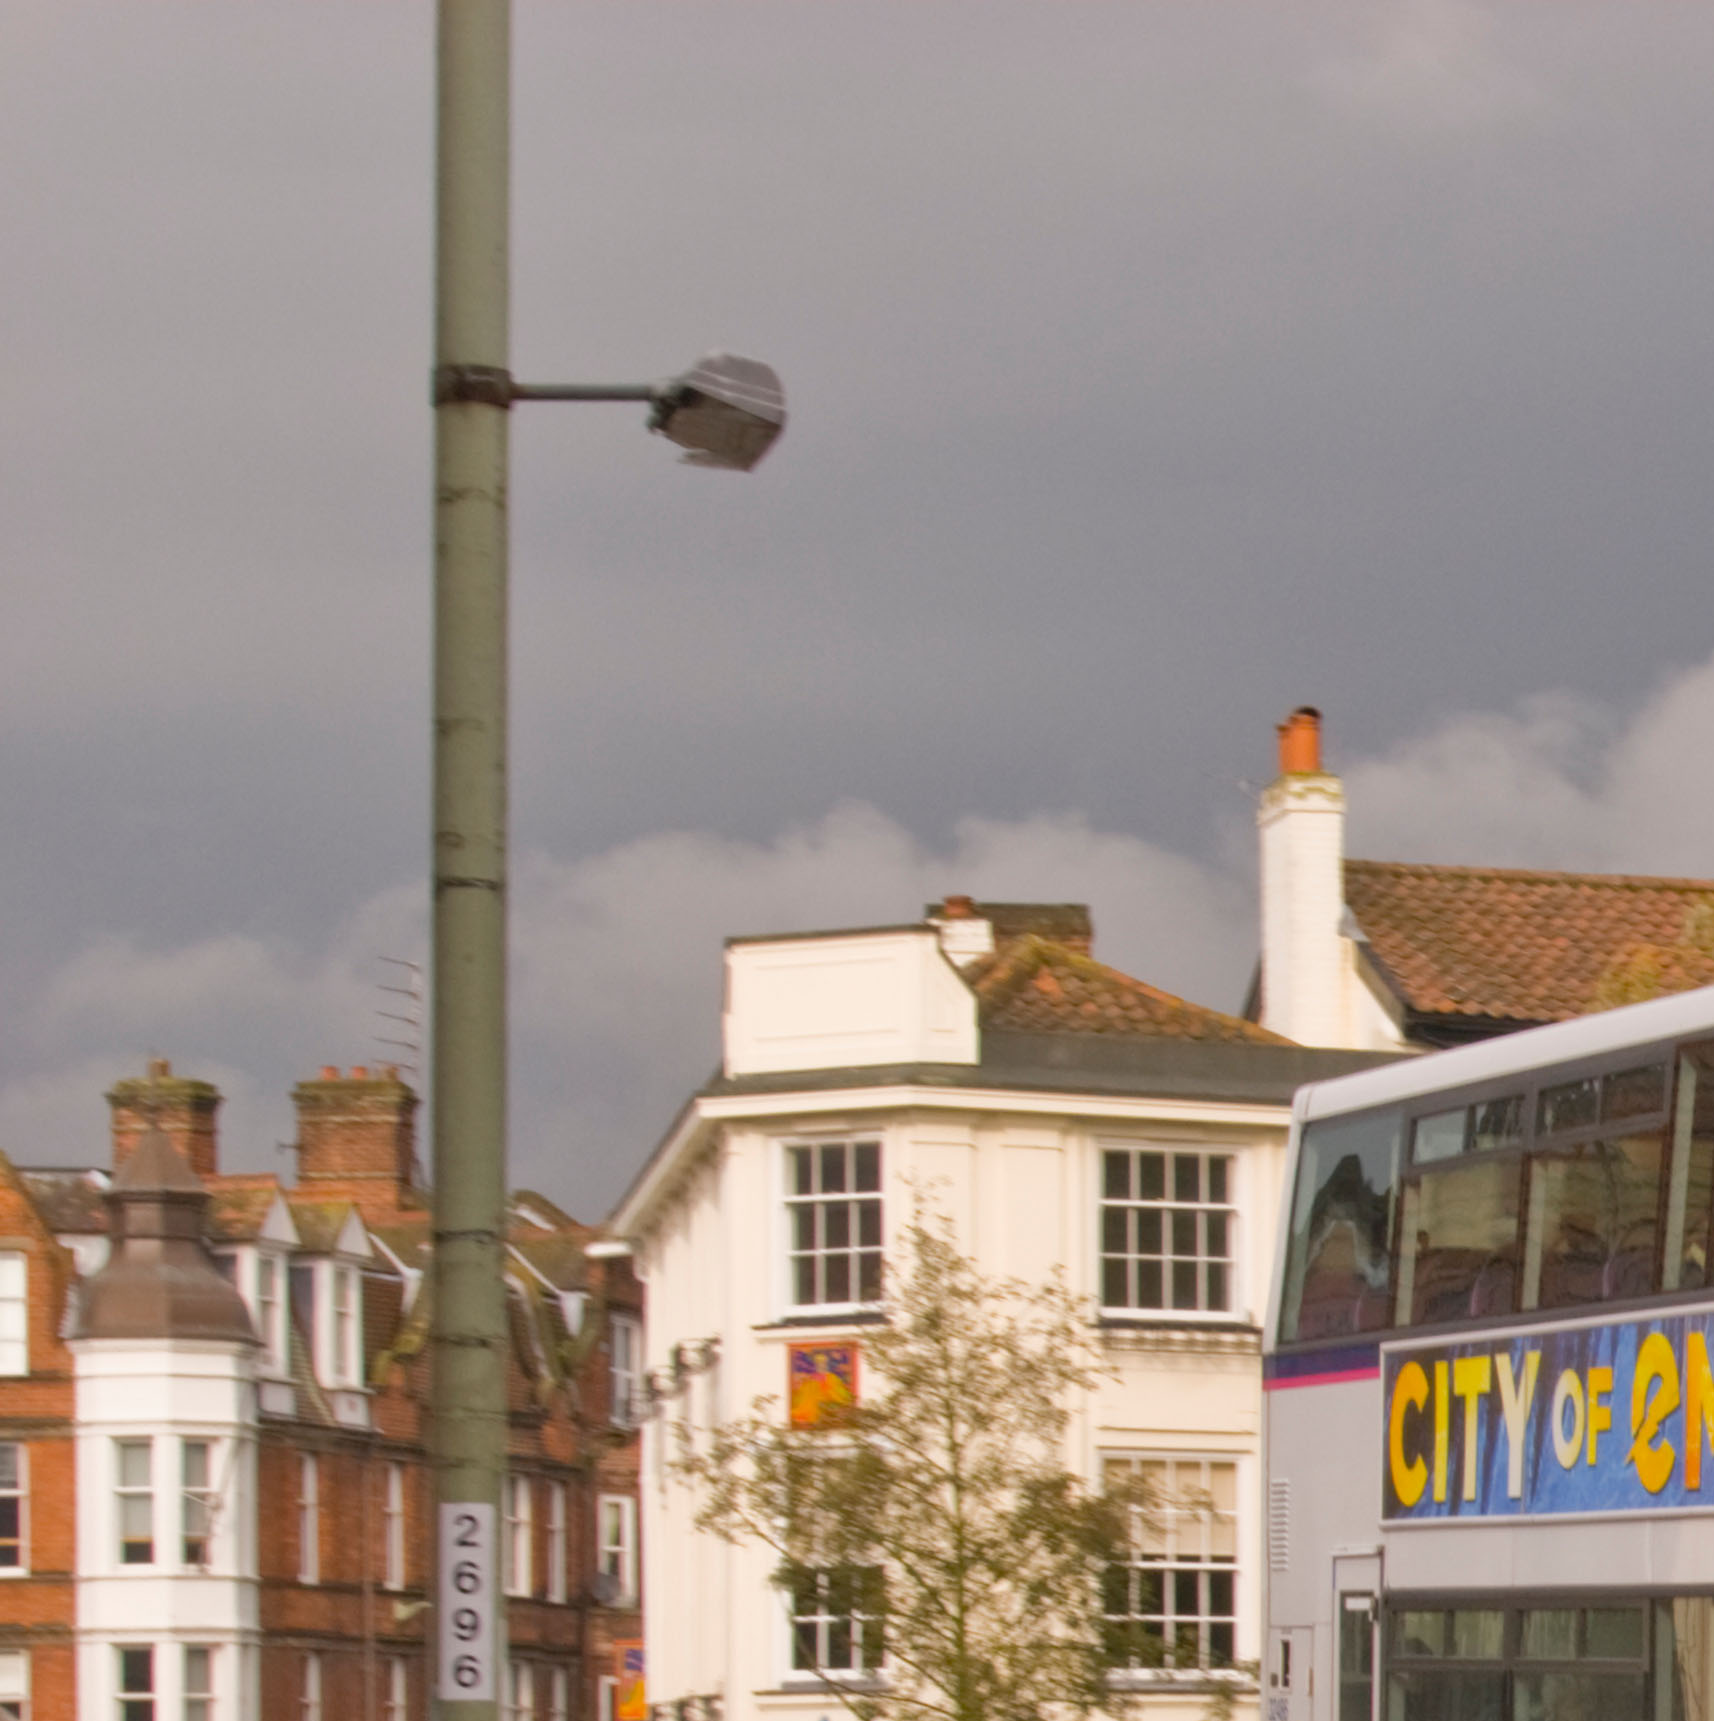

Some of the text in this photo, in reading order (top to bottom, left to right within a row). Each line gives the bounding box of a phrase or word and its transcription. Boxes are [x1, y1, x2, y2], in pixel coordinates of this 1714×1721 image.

[1388, 1350, 1541, 1508] CITY
[1551, 1366, 1612, 1471] OF
[453, 1513, 482, 1689] 2696
